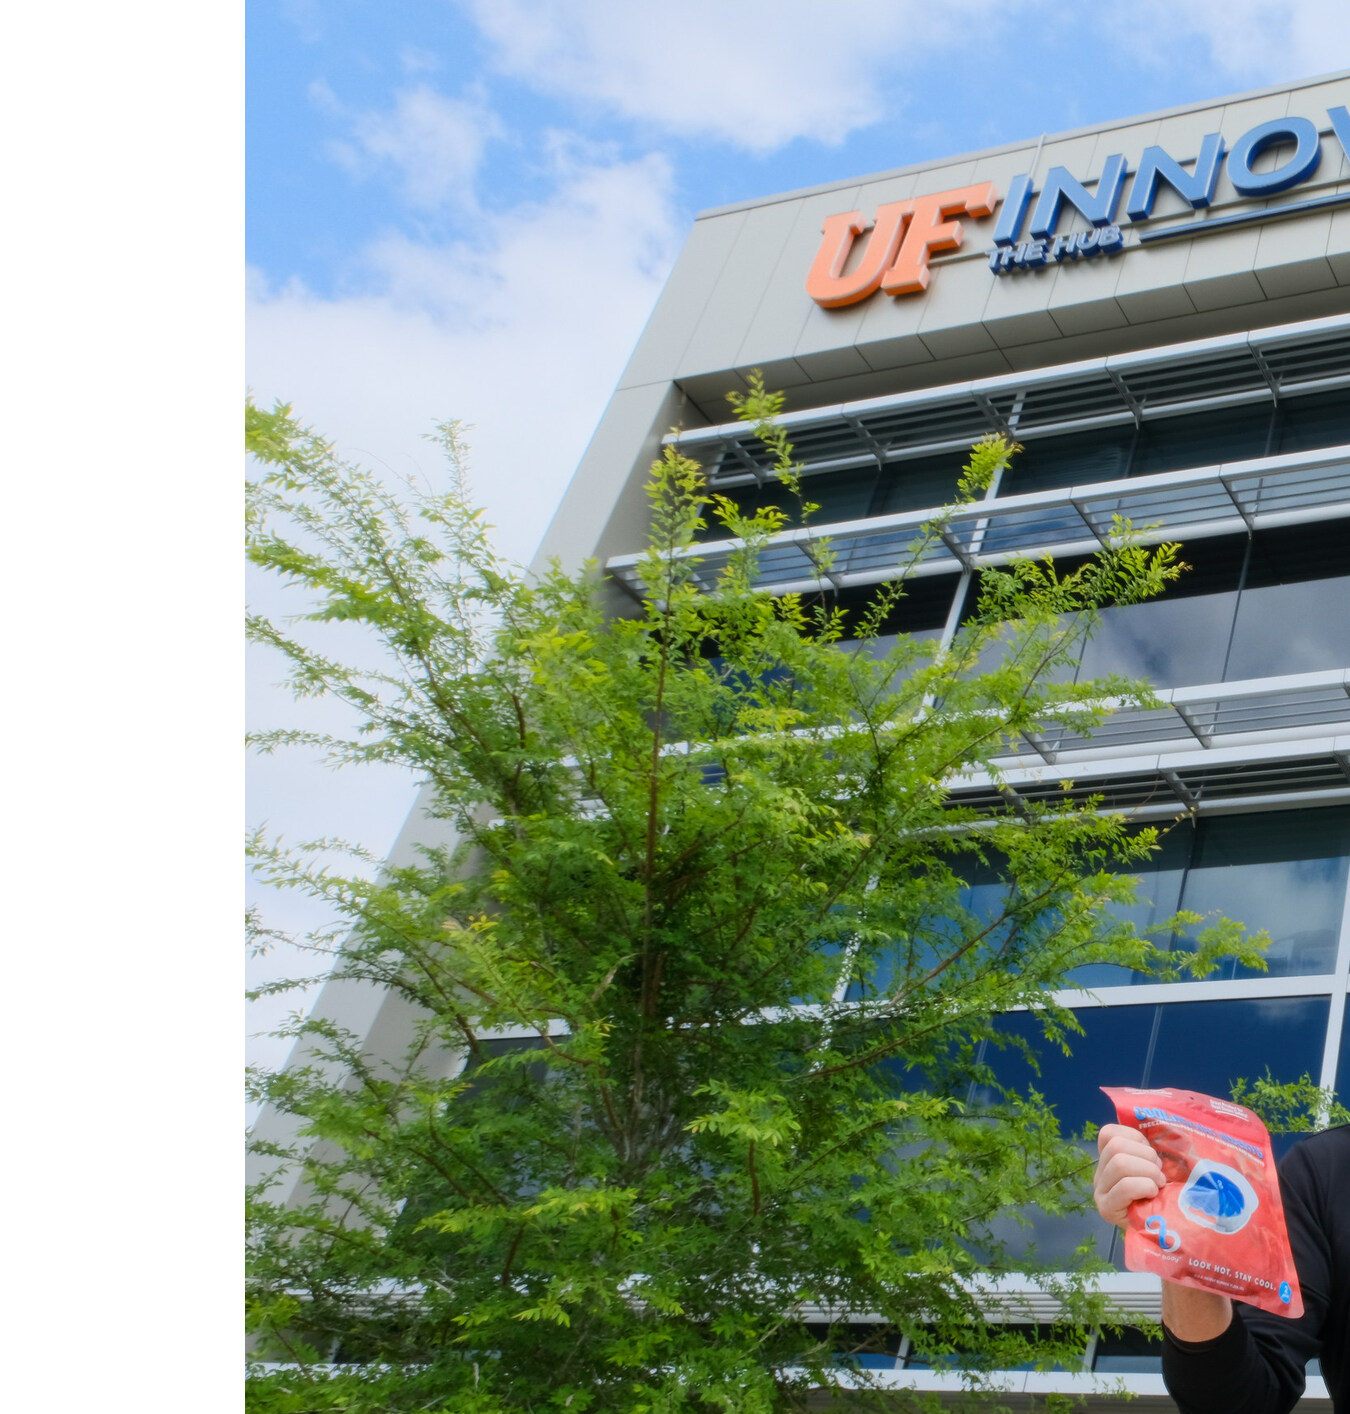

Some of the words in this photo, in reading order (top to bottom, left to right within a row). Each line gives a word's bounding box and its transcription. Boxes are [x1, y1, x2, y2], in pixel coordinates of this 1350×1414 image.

[805, 181, 997, 309] UF
[985, 239, 1050, 275] THE
[1052, 225, 1123, 262] HUB
[1188, 1257, 1212, 1271] LOOK
[1213, 1264, 1233, 1278] HOT,
[1234, 1270, 1252, 1283] STAY
[1254, 1277, 1277, 1291] COOL.
